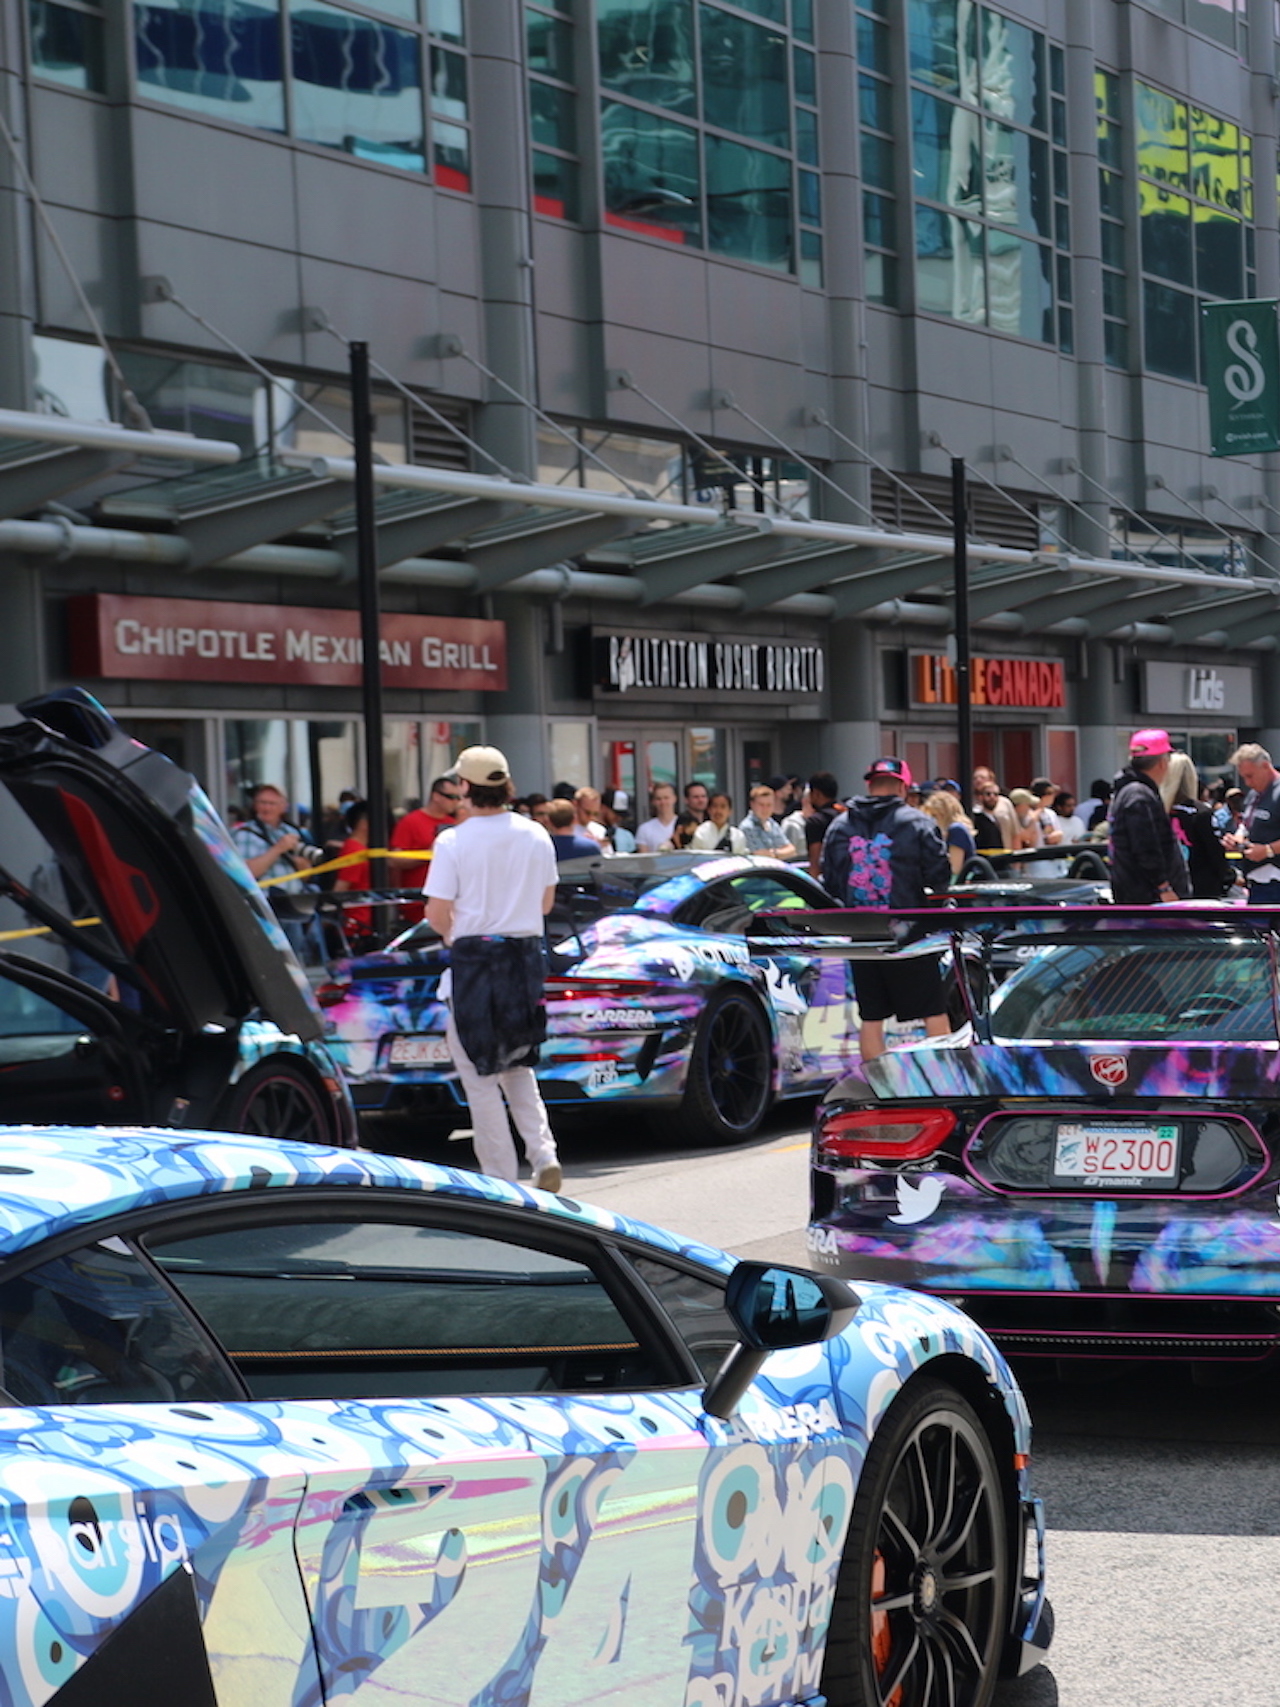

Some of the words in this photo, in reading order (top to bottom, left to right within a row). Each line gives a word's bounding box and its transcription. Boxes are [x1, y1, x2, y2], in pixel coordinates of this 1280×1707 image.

[115, 618, 276, 661] CHIPOTLE
[421, 637, 498, 671] GRILL
[715, 642, 760, 691] SUSHI
[766, 645, 824, 693] BURRITO
[987, 658, 1067, 708] CANADA
[1190, 668, 1224, 710] Lids
[581, 1009, 656, 1025] CARRERA
[1101, 1139, 1173, 1172] 2300
